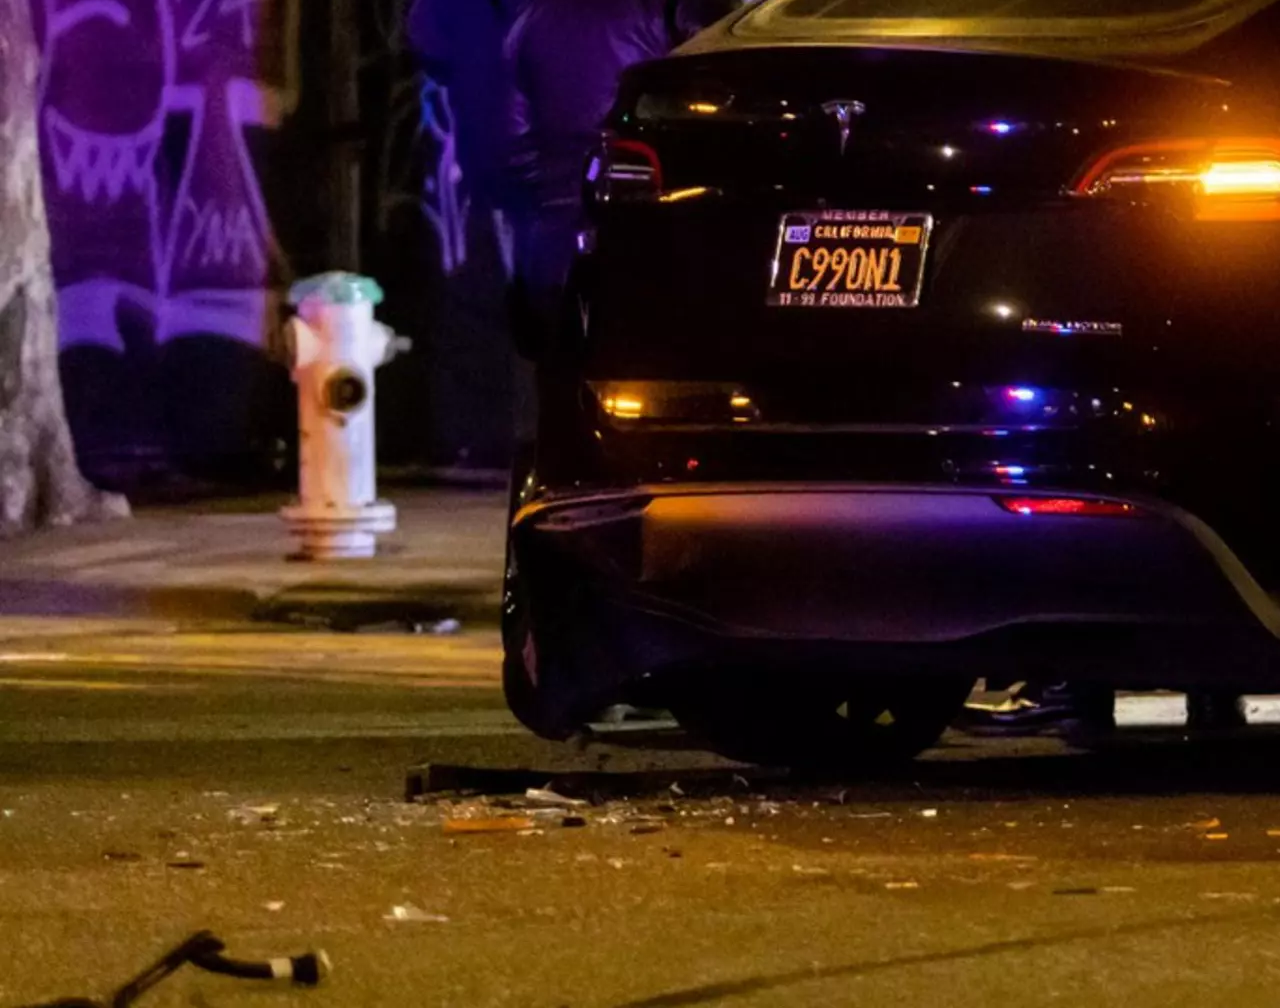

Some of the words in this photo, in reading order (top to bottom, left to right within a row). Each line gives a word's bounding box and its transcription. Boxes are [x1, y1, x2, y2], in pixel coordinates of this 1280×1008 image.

[821, 209, 890, 221] MEMBER
[789, 228, 809, 241] AUG
[814, 225, 894, 239] CALIFORNIA
[820, 293, 905, 306] FOUNDATION
